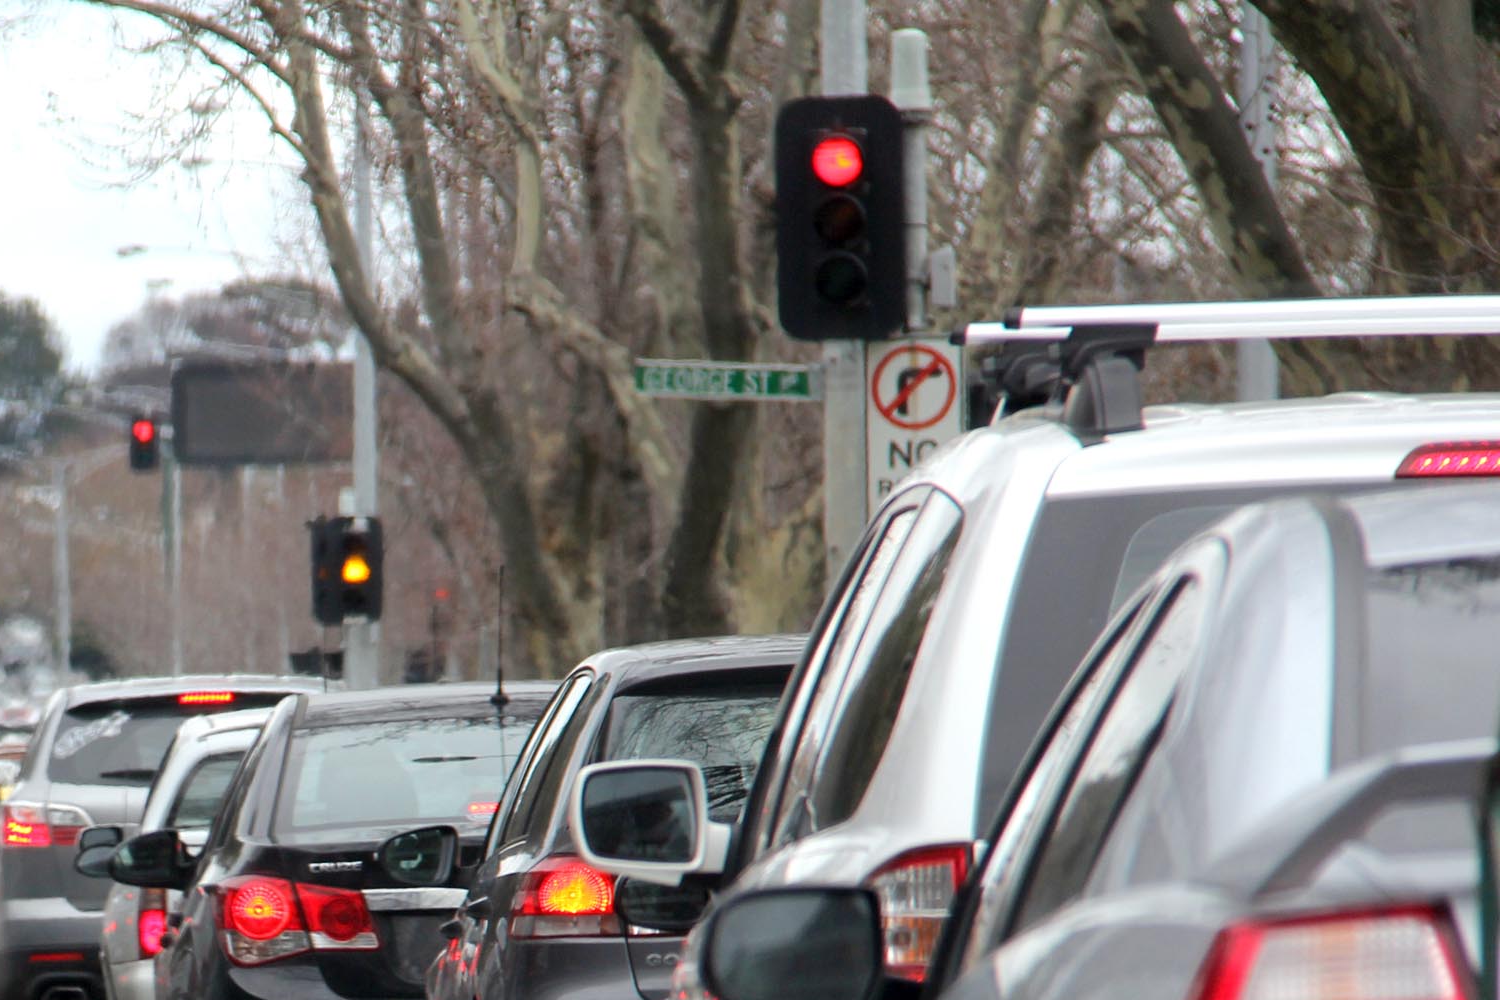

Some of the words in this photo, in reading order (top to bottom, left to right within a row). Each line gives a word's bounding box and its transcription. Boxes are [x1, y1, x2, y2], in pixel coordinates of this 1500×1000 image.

[644, 367, 736, 394] GEORGE
[746, 370, 771, 395] ST
[308, 861, 363, 874] CRUZE
[646, 953, 680, 968] GO
